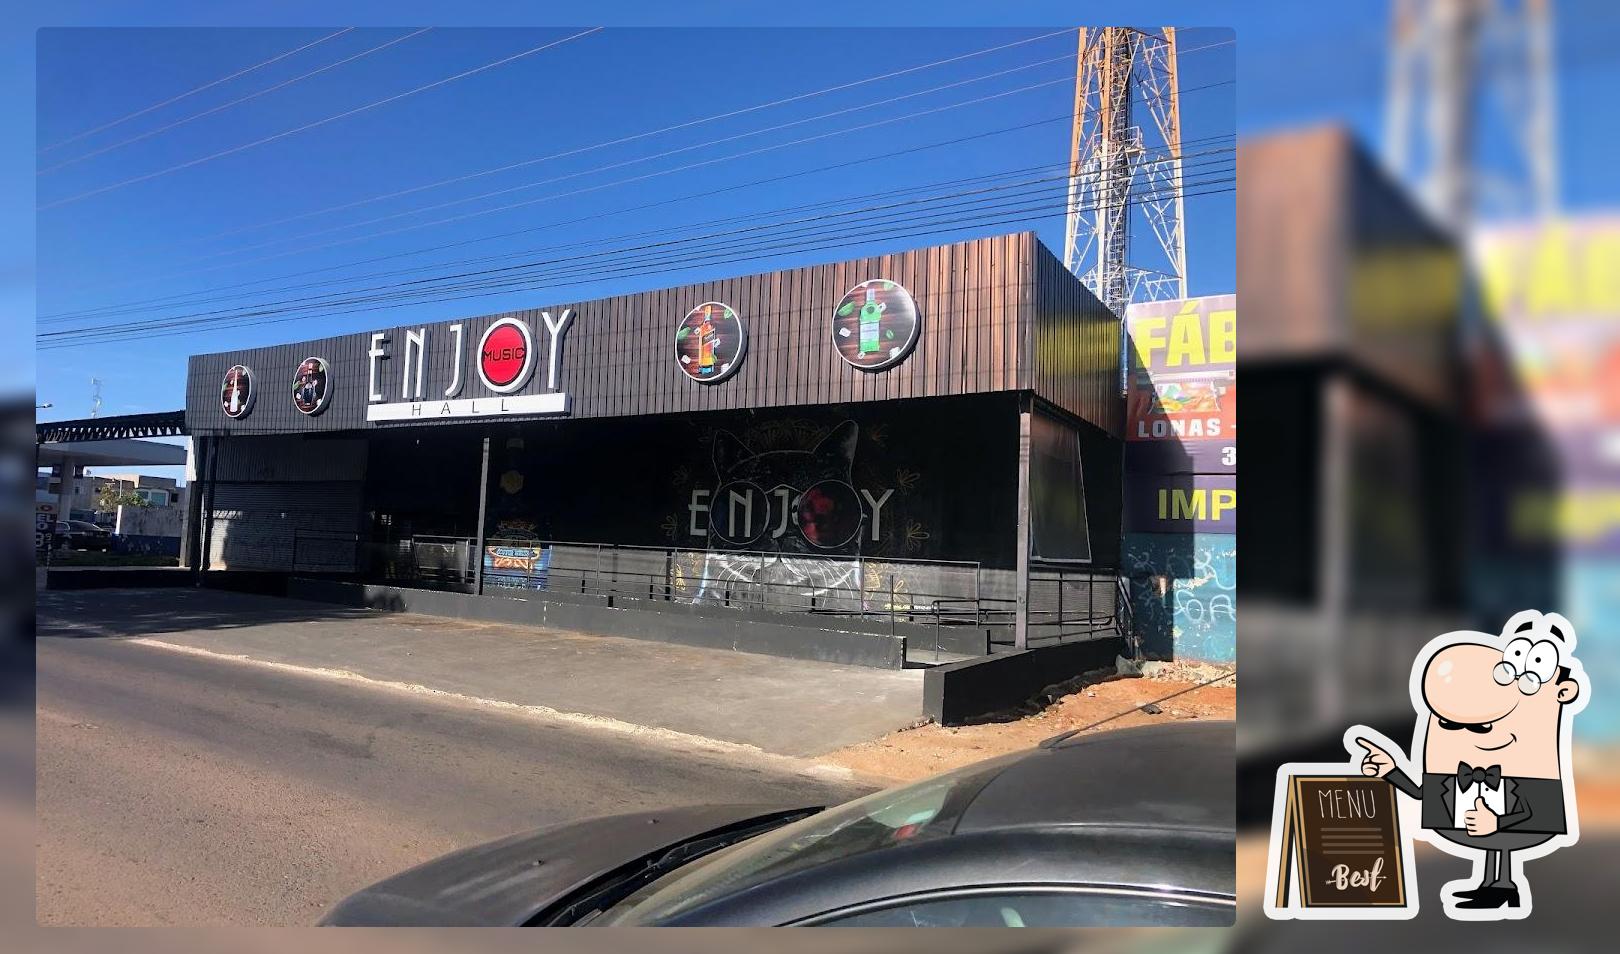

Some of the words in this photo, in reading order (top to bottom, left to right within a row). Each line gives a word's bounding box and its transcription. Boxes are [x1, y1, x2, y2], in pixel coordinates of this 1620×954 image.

[1135, 300, 1236, 368] FÁB
[368, 308, 571, 402] ENJOY
[482, 346, 526, 362] MUSIC
[411, 398, 510, 417] HALL
[1137, 418, 1221, 438] LONAS
[688, 480, 895, 548] ENJOY
[1158, 489, 1236, 521] IMP
